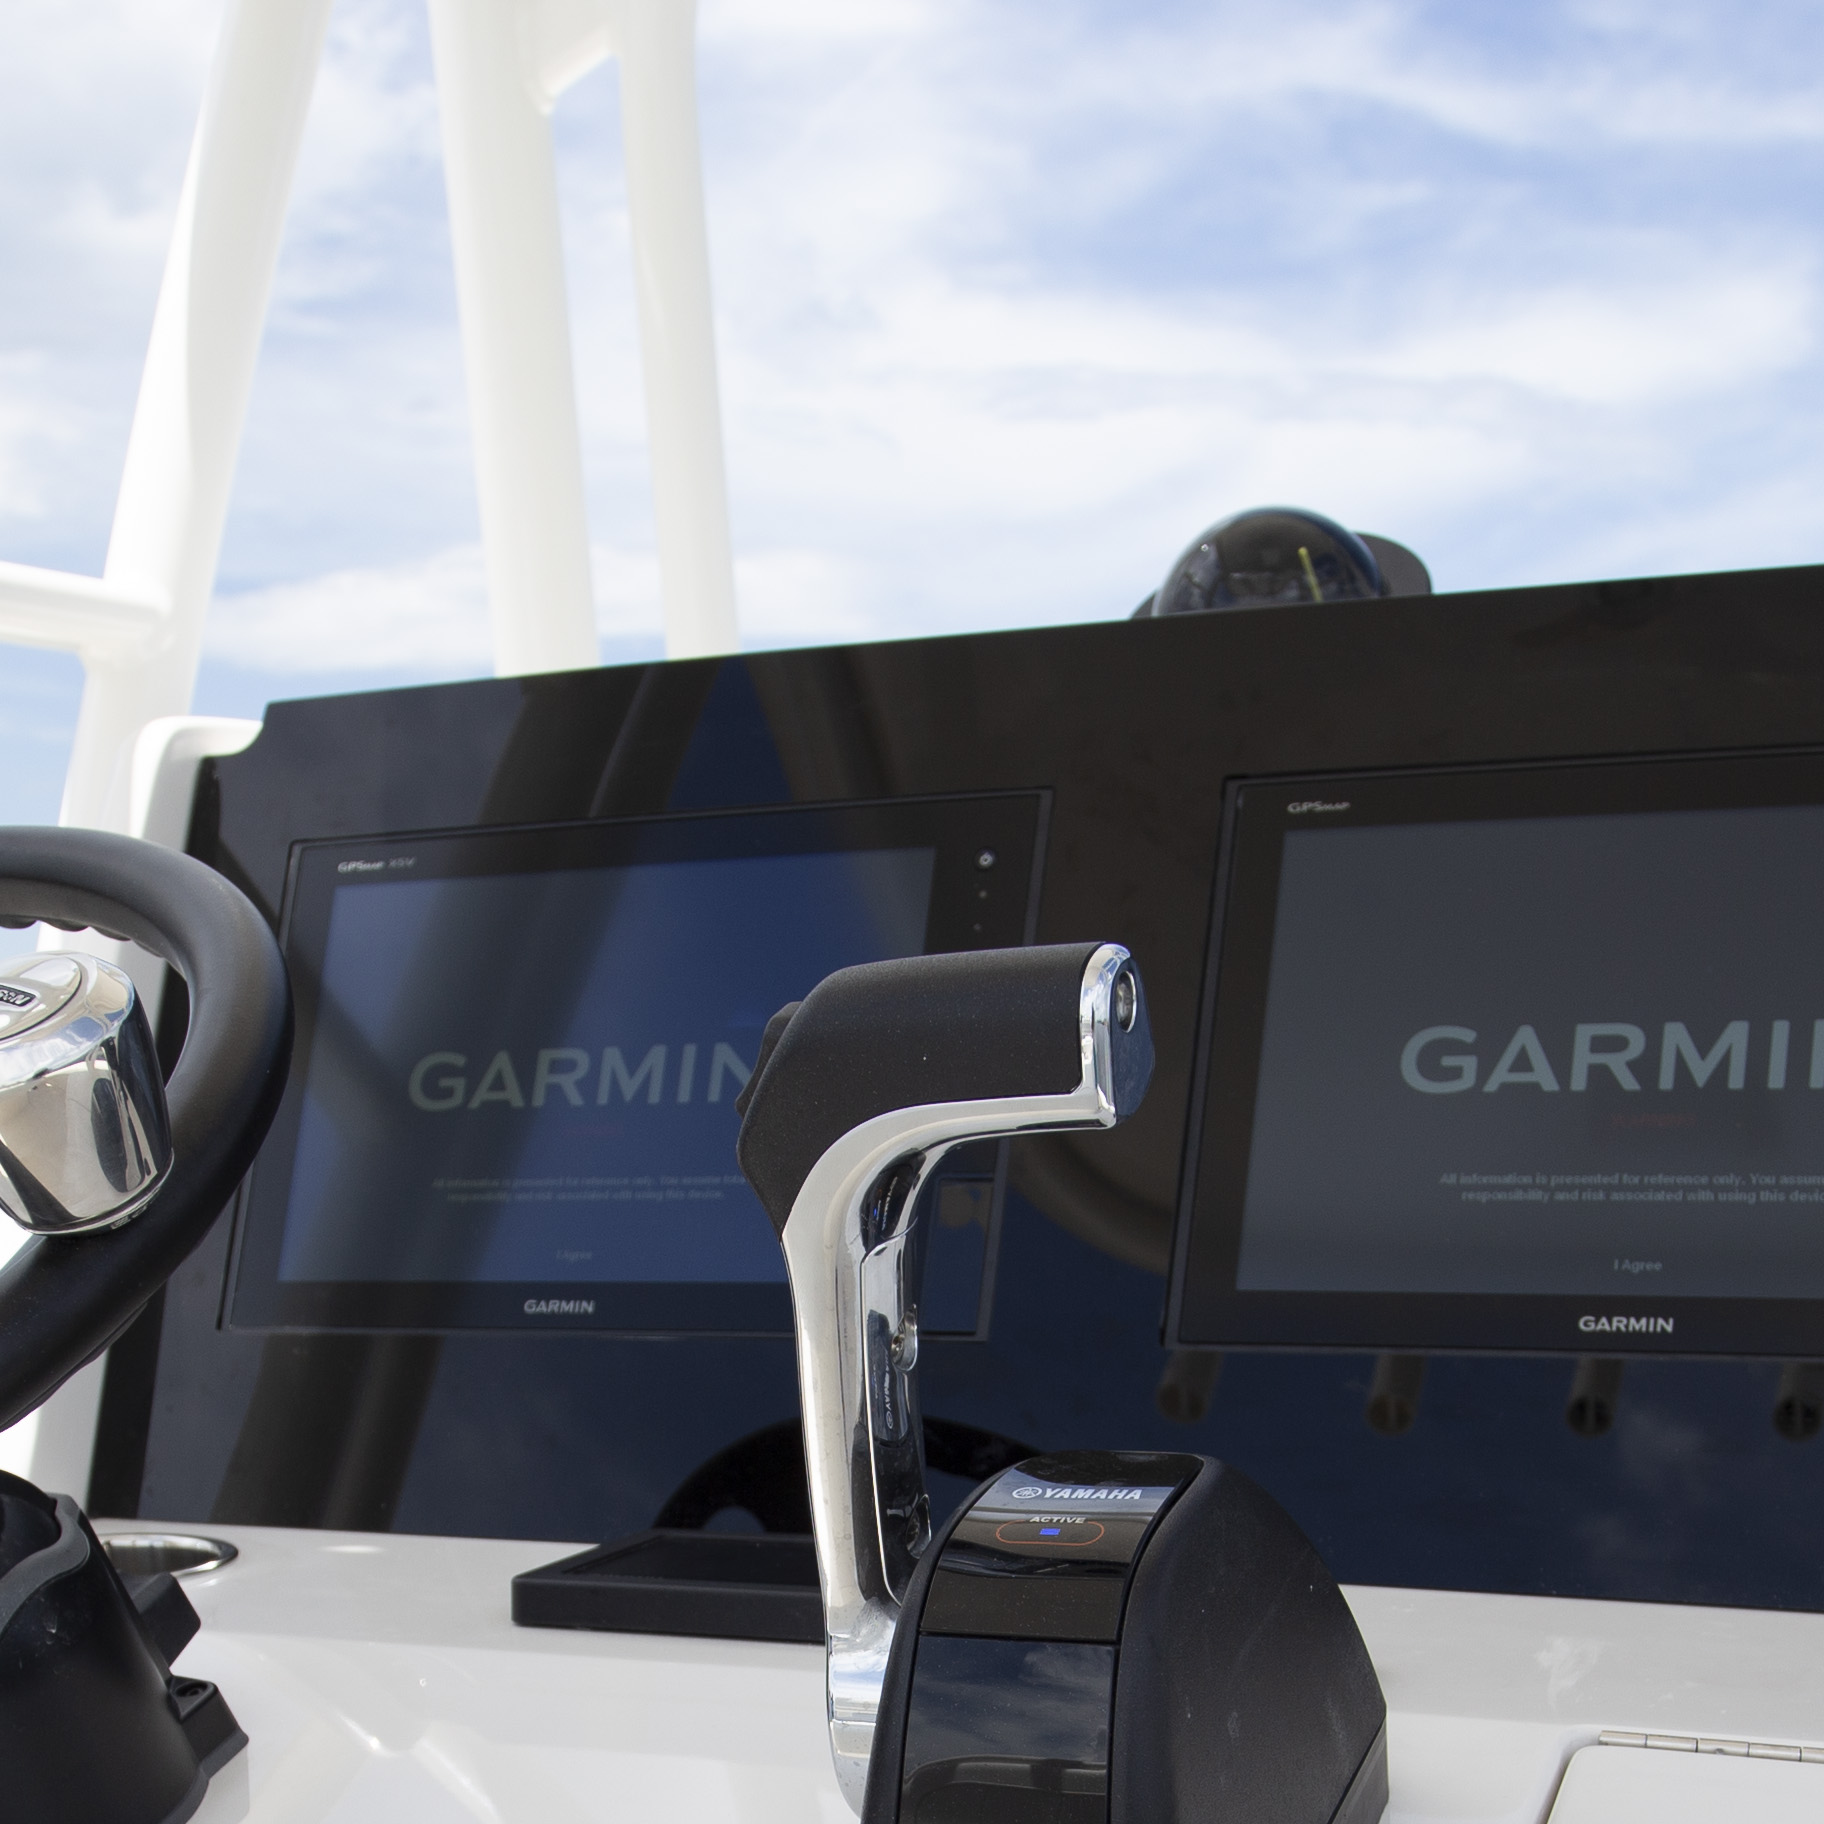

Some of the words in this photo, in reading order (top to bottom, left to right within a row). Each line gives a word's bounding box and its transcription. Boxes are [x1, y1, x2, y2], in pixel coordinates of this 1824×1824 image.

[1439, 1173, 1457, 1185] All
[1459, 1173, 1532, 1185] information
[1536, 1173, 1547, 1185] is
[1550, 1173, 1619, 1187] presented
[1622, 1173, 1640, 1185] for
[1643, 1173, 1710, 1185] reference
[1712, 1173, 1746, 1187] only.
[1750, 1173, 1776, 1185] You
[1461, 1189, 1550, 1203] responsibility
[1554, 1189, 1578, 1201] and
[1582, 1189, 1606, 1201] risk
[1610, 1189, 1683, 1201] associated
[1687, 1189, 1715, 1201] with
[1718, 1189, 1756, 1204] using
[1760, 1189, 1786, 1201] this
[1622, 1259, 1663, 1273] Agree
[523, 1299, 595, 1314] GARMIN
[1578, 1315, 1674, 1333] GARMIN
[1043, 1487, 1143, 1500] YAMAHA
[1029, 1516, 1087, 1525] ACTIVE
